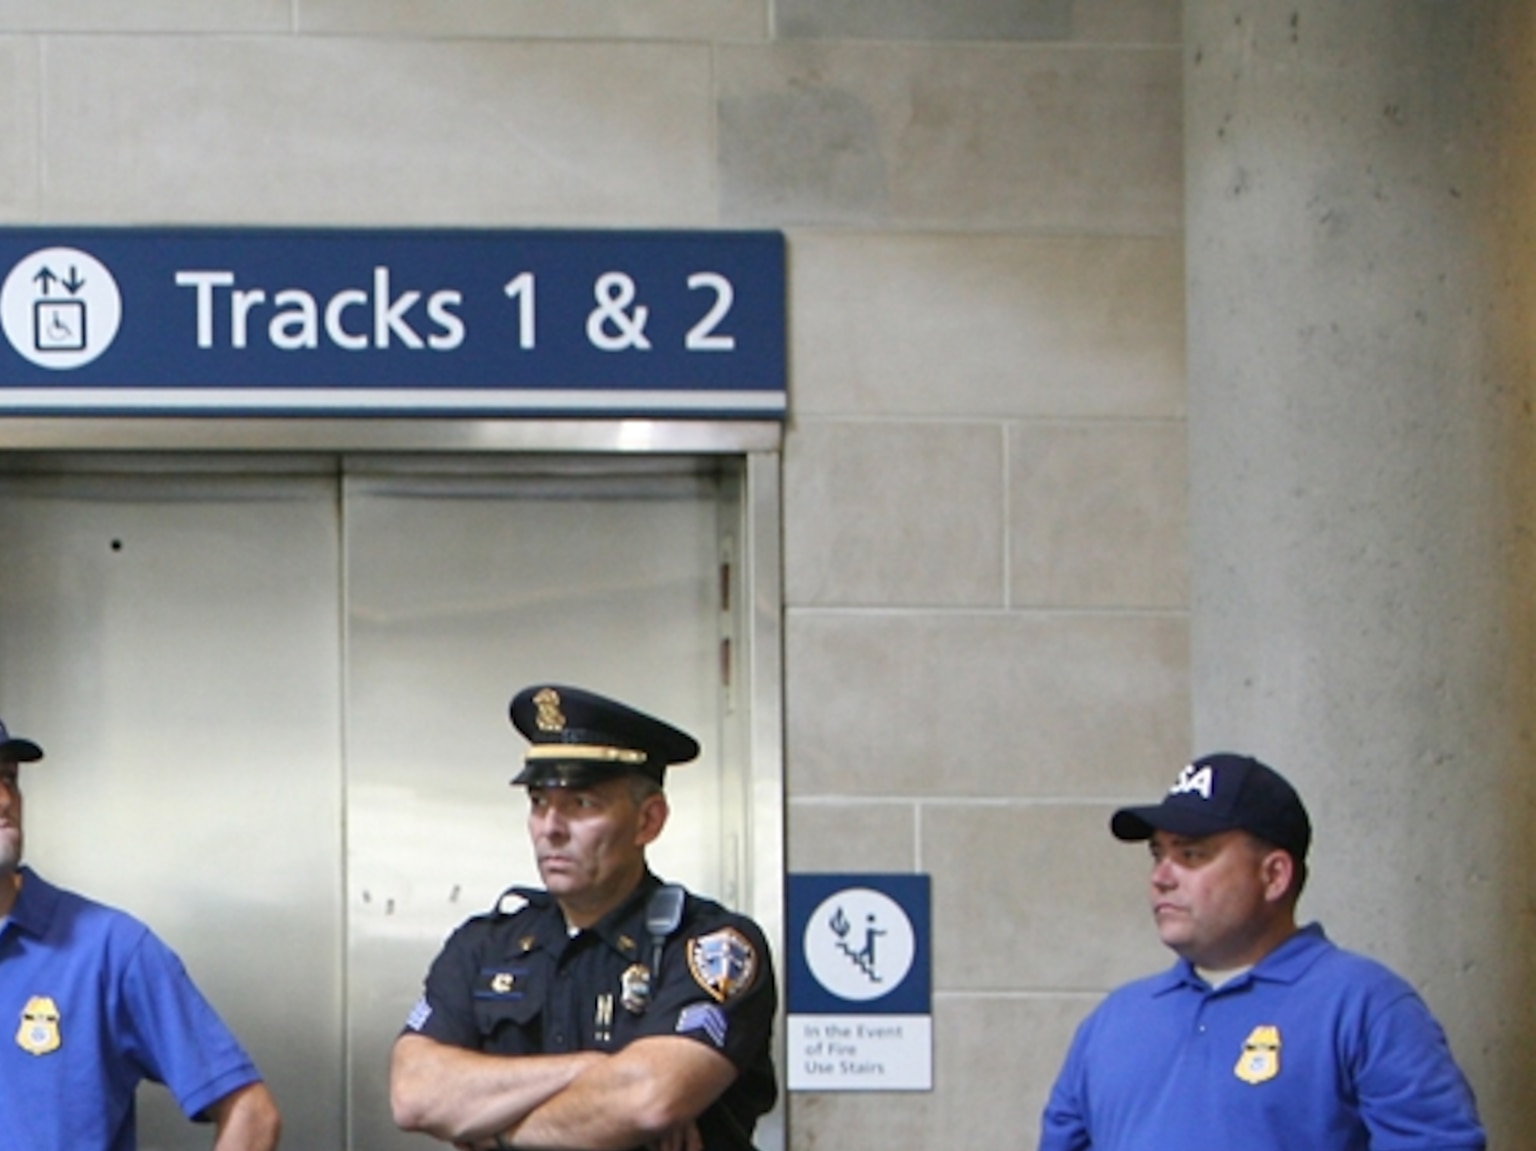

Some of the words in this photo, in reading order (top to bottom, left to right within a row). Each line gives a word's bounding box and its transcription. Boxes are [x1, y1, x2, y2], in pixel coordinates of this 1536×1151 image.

[176, 267, 465, 350] Tracks
[503, 272, 538, 349] 1
[585, 271, 652, 350] &
[685, 272, 736, 350] 2
[1170, 764, 1214, 799] SA
[824, 1024, 851, 1038] the
[856, 1025, 903, 1038] Event
[827, 1042, 857, 1055] Fire
[804, 1061, 834, 1075] Use
[839, 1061, 885, 1075] Stairs
